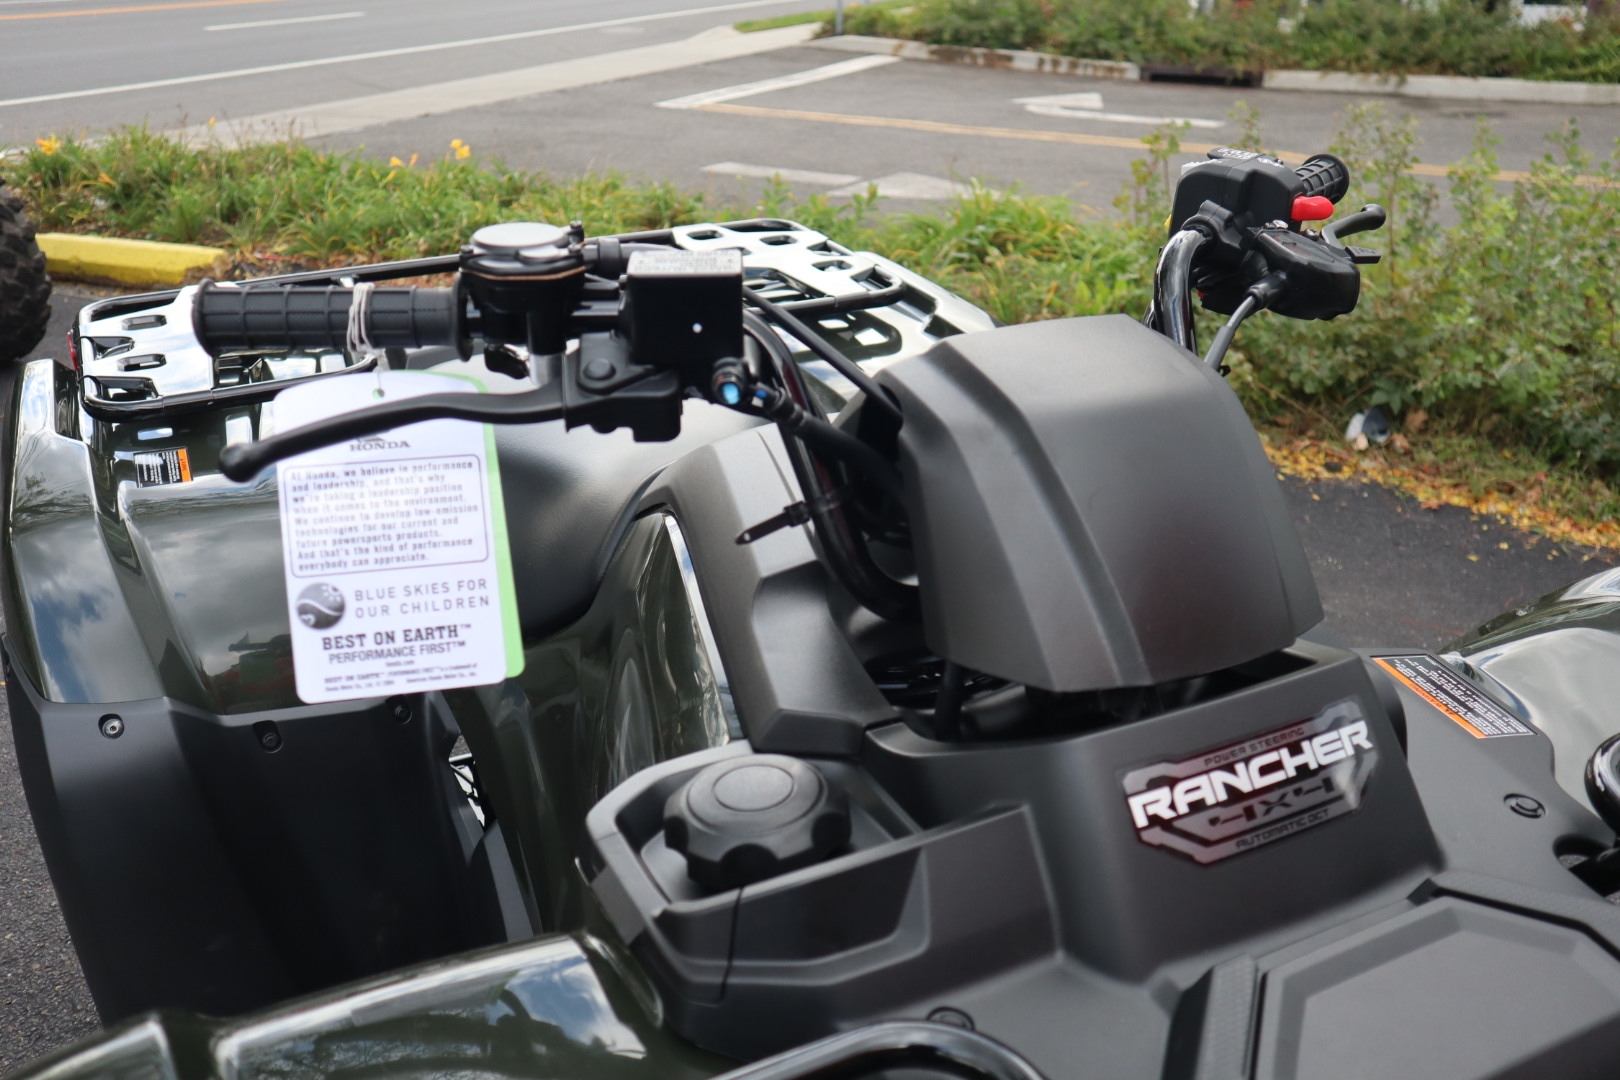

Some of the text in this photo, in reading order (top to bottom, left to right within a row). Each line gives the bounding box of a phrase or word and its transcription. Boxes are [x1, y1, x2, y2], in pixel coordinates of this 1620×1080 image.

[350, 440, 411, 452] HONDA
[343, 469, 356, 477] we
[360, 466, 395, 476] believe
[412, 462, 472, 473] performance
[292, 482, 308, 492] and
[423, 484, 462, 495] position
[442, 515, 458, 525] and
[332, 533, 392, 546] powersports
[298, 550, 315, 560] And
[354, 547, 369, 555] the
[374, 543, 394, 553] kind
[412, 538, 472, 550] performance
[352, 558, 369, 567] can
[355, 578, 487, 601] BLUE SKIES FOR
[355, 596, 489, 619] OUR CHILDREN
[322, 634, 366, 650] BEST
[374, 630, 396, 645] ON
[328, 646, 416, 664] PERFORMANCE
[1204, 727, 1305, 766] POWER STEERING
[1128, 720, 1373, 829] RANCHER
[1236, 808, 1330, 850] AUTOMATIC DCT
